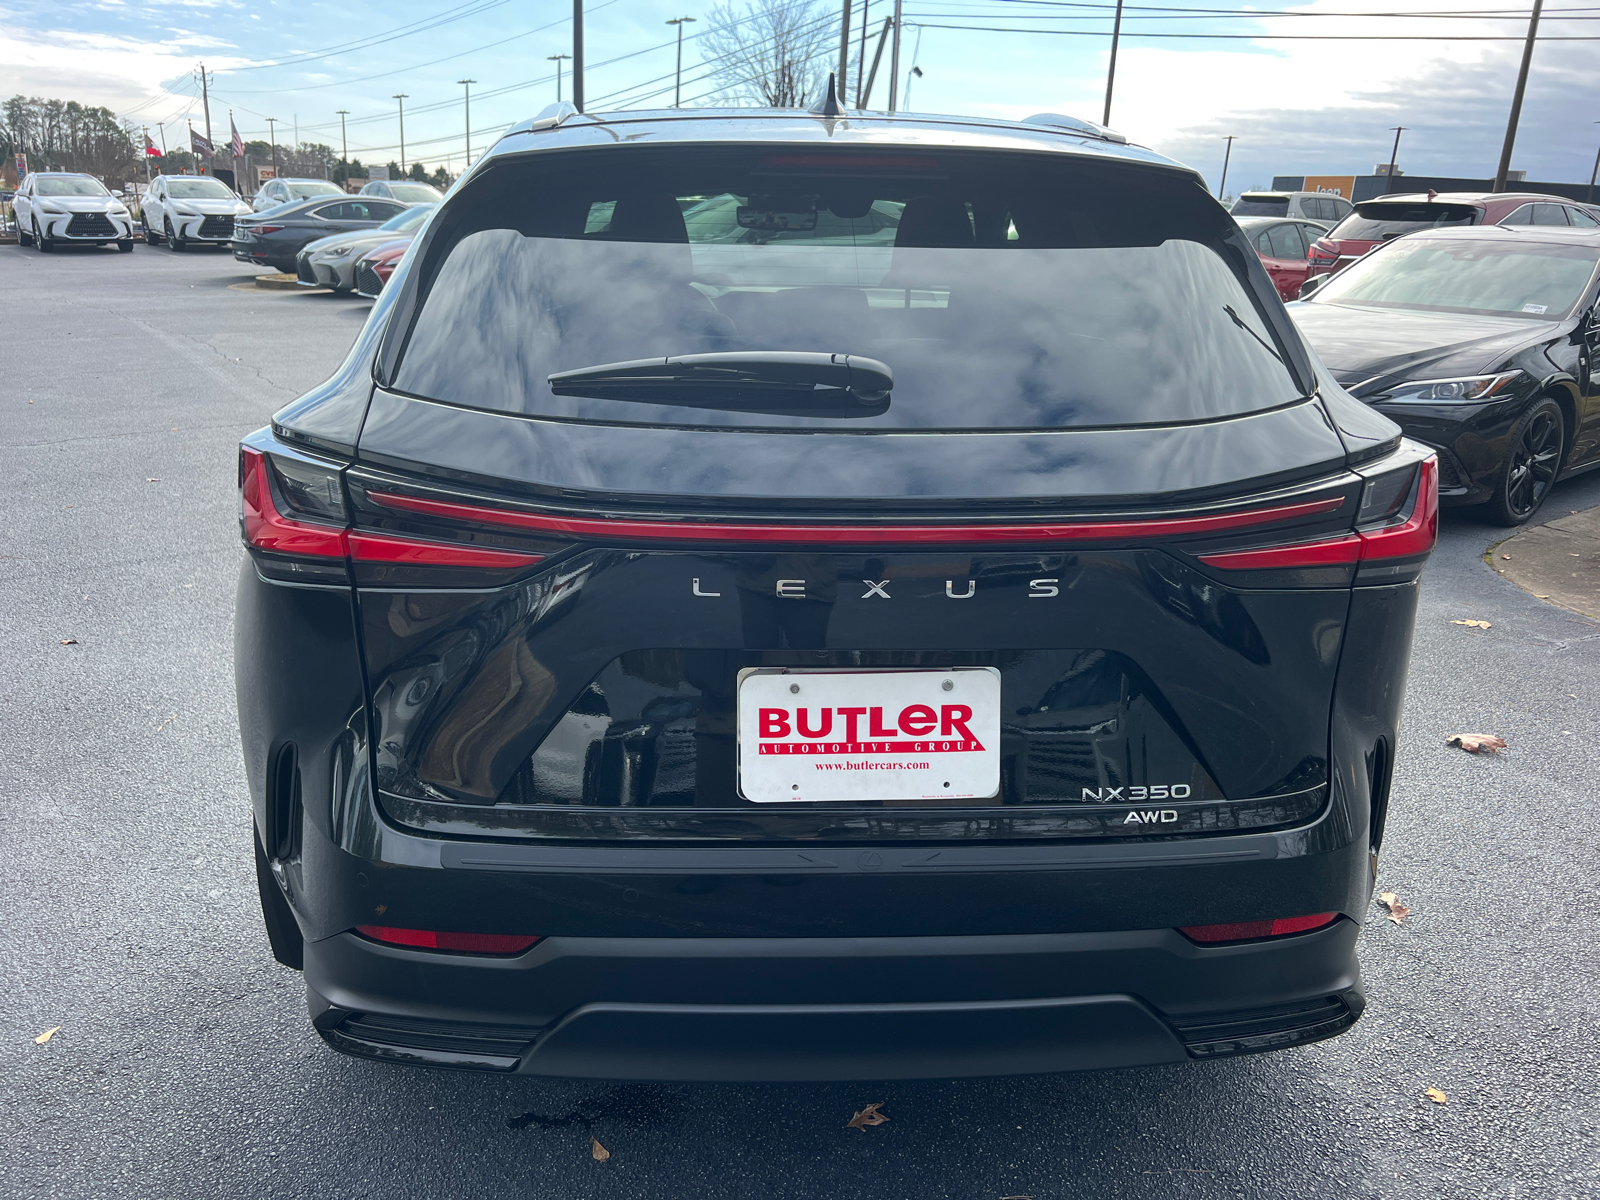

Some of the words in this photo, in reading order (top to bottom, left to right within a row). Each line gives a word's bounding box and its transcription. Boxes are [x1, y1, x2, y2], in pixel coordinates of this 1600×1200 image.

[692, 577, 1060, 599] LEXUS
[760, 742, 892, 754] AUTOMOTIVE
[914, 740, 978, 752] GROUP
[815, 760, 930, 771] www.butlercars.com
[1123, 810, 1179, 825] AWD
